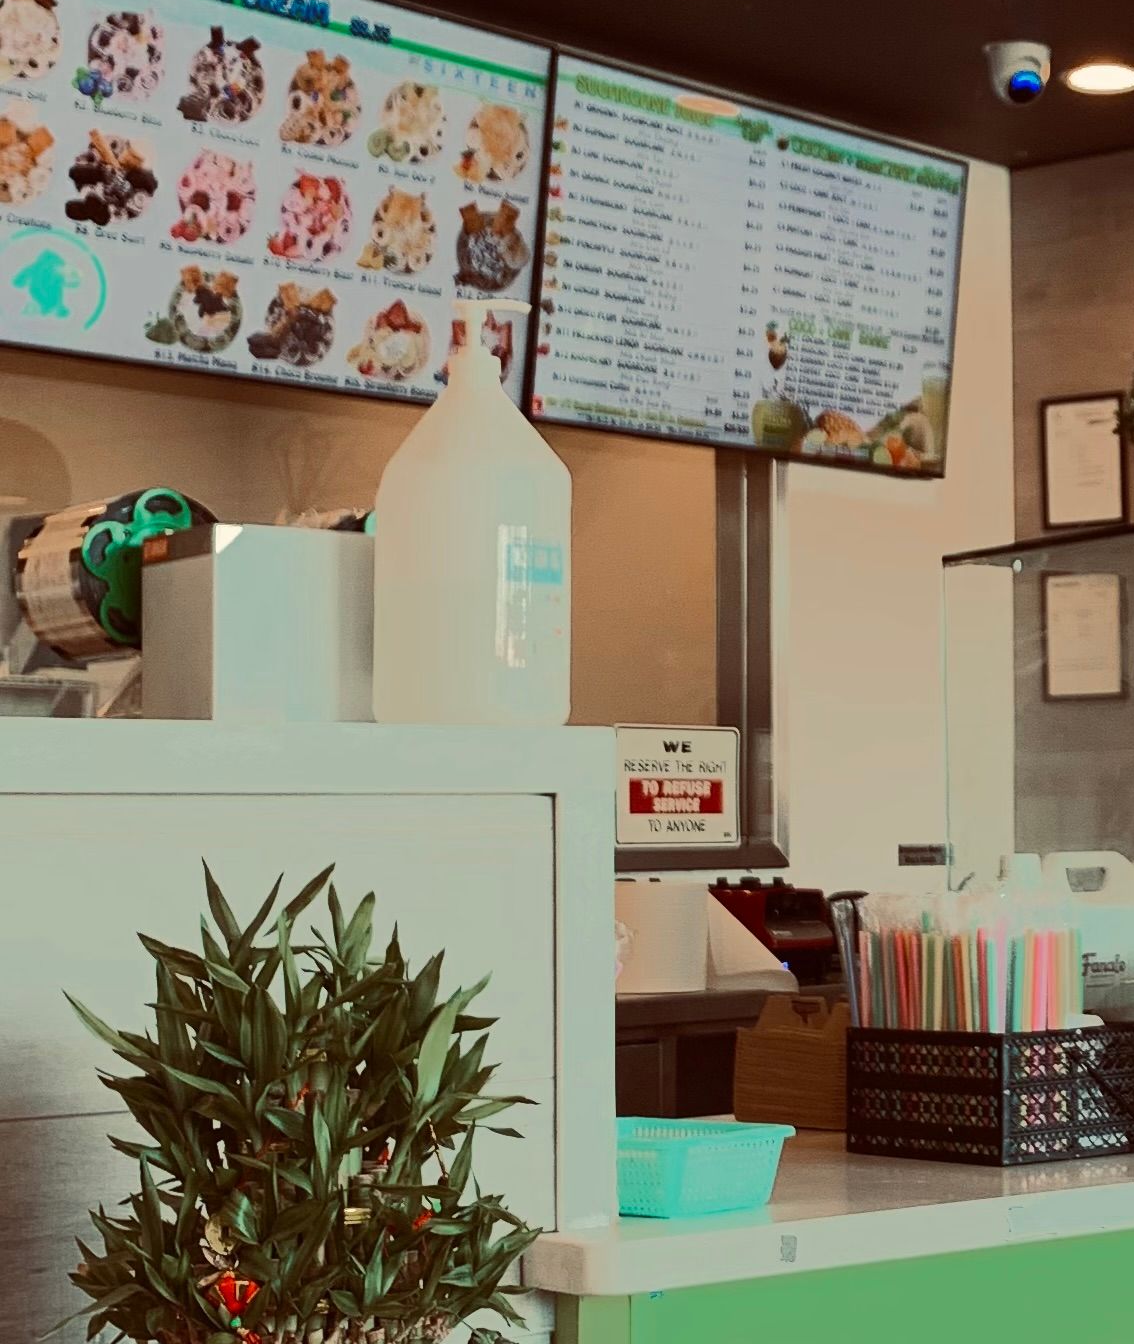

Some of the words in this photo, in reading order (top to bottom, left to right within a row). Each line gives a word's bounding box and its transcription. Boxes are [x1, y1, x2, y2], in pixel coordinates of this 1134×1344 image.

[663, 741, 692, 753] WE
[624, 759, 670, 773] RESERVE
[676, 760, 693, 773] THE
[699, 761, 727, 773] RIGHT
[641, 779, 659, 796] TO
[662, 780, 711, 798] REFUSE
[653, 797, 701, 814] SERVICE
[649, 819, 661, 832] TO
[666, 819, 706, 832] ANYONE
